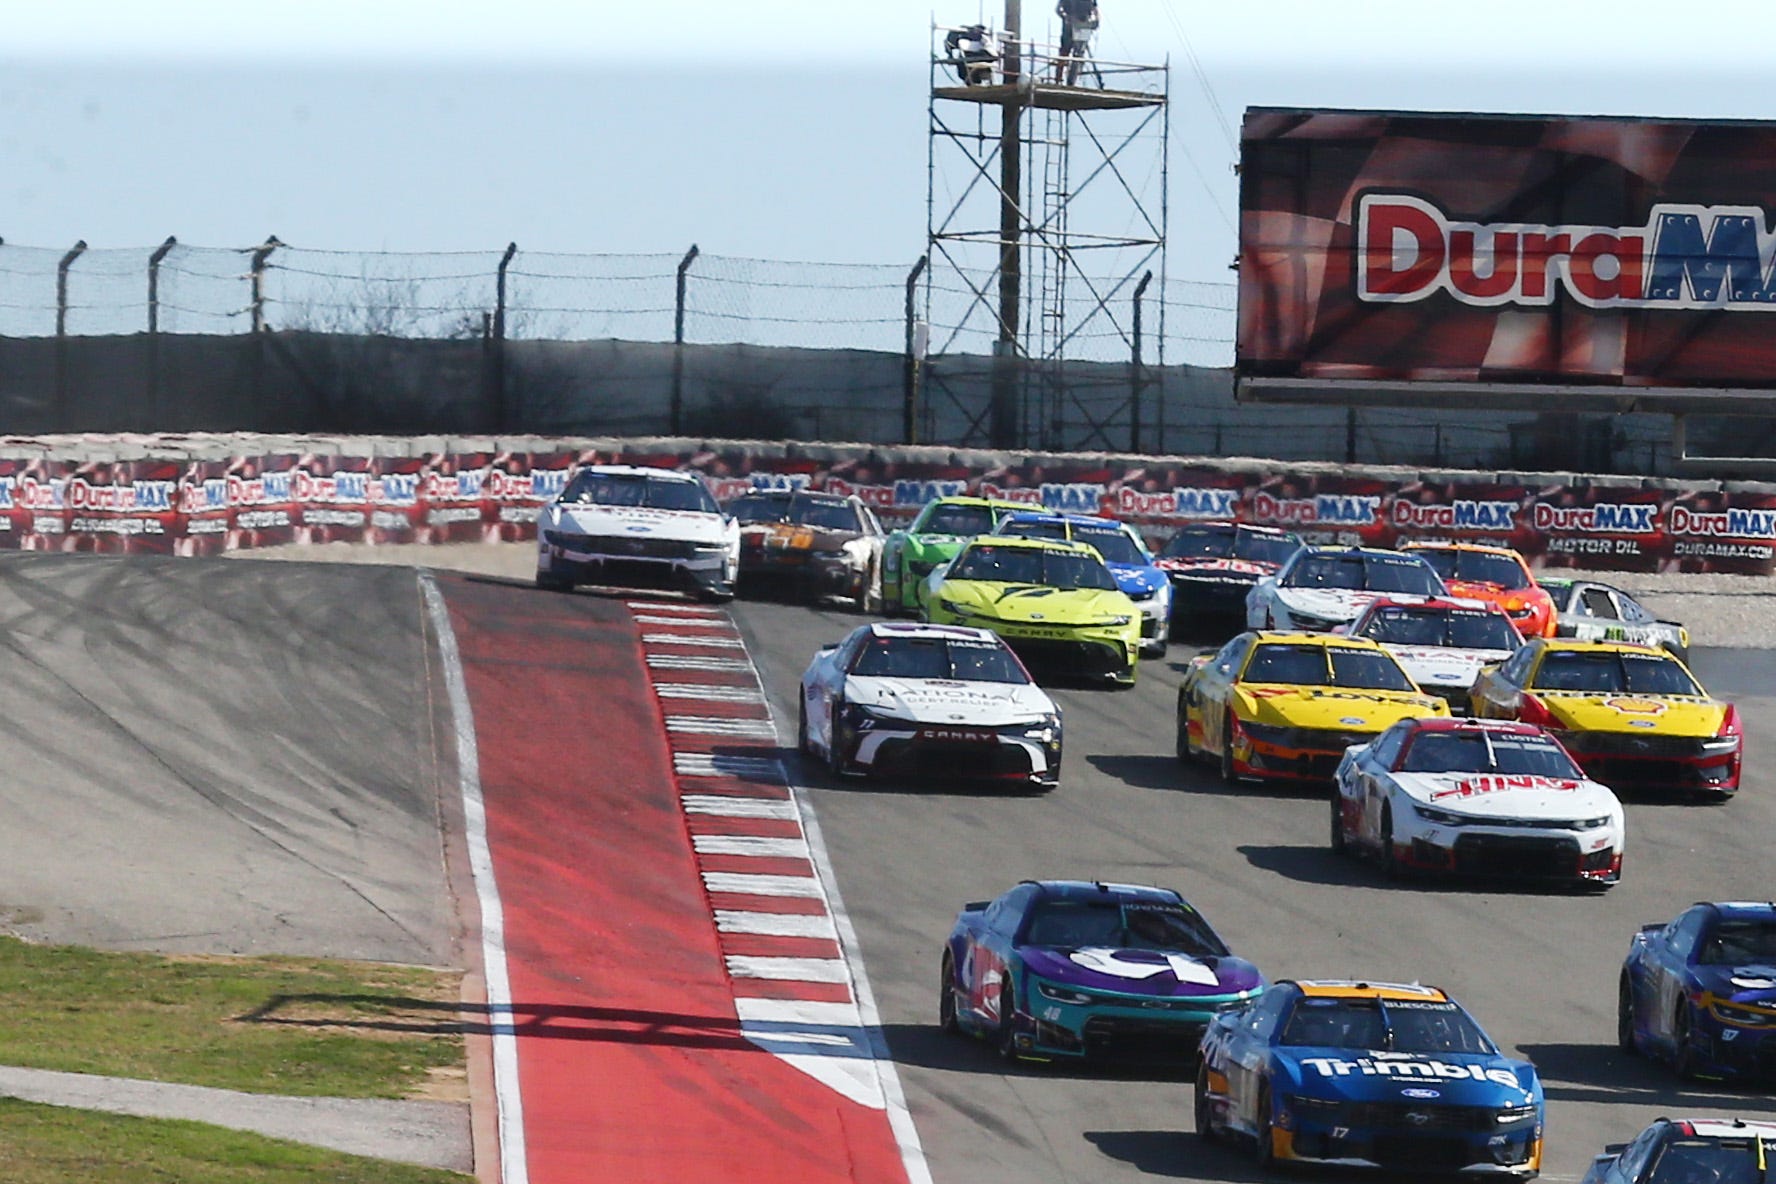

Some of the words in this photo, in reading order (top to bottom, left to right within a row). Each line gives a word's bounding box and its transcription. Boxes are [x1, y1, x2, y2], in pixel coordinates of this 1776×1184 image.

[1254, 491, 1381, 525] DuraMAX
[1392, 495, 1518, 531] DuraMAX
[1534, 502, 1658, 533] DuraMAX
[1549, 538, 1611, 556] MOTOR
[1615, 540, 1641, 555] OIL
[1674, 541, 1773, 559] DURAMAX.COM
[923, 730, 992, 741] CAMRY
[1501, 734, 1547, 744] CUSTER
[1383, 1000, 1456, 1012] BUESCHER
[1301, 1058, 1520, 1089] Trimble
[1332, 1126, 1350, 1139] 17
